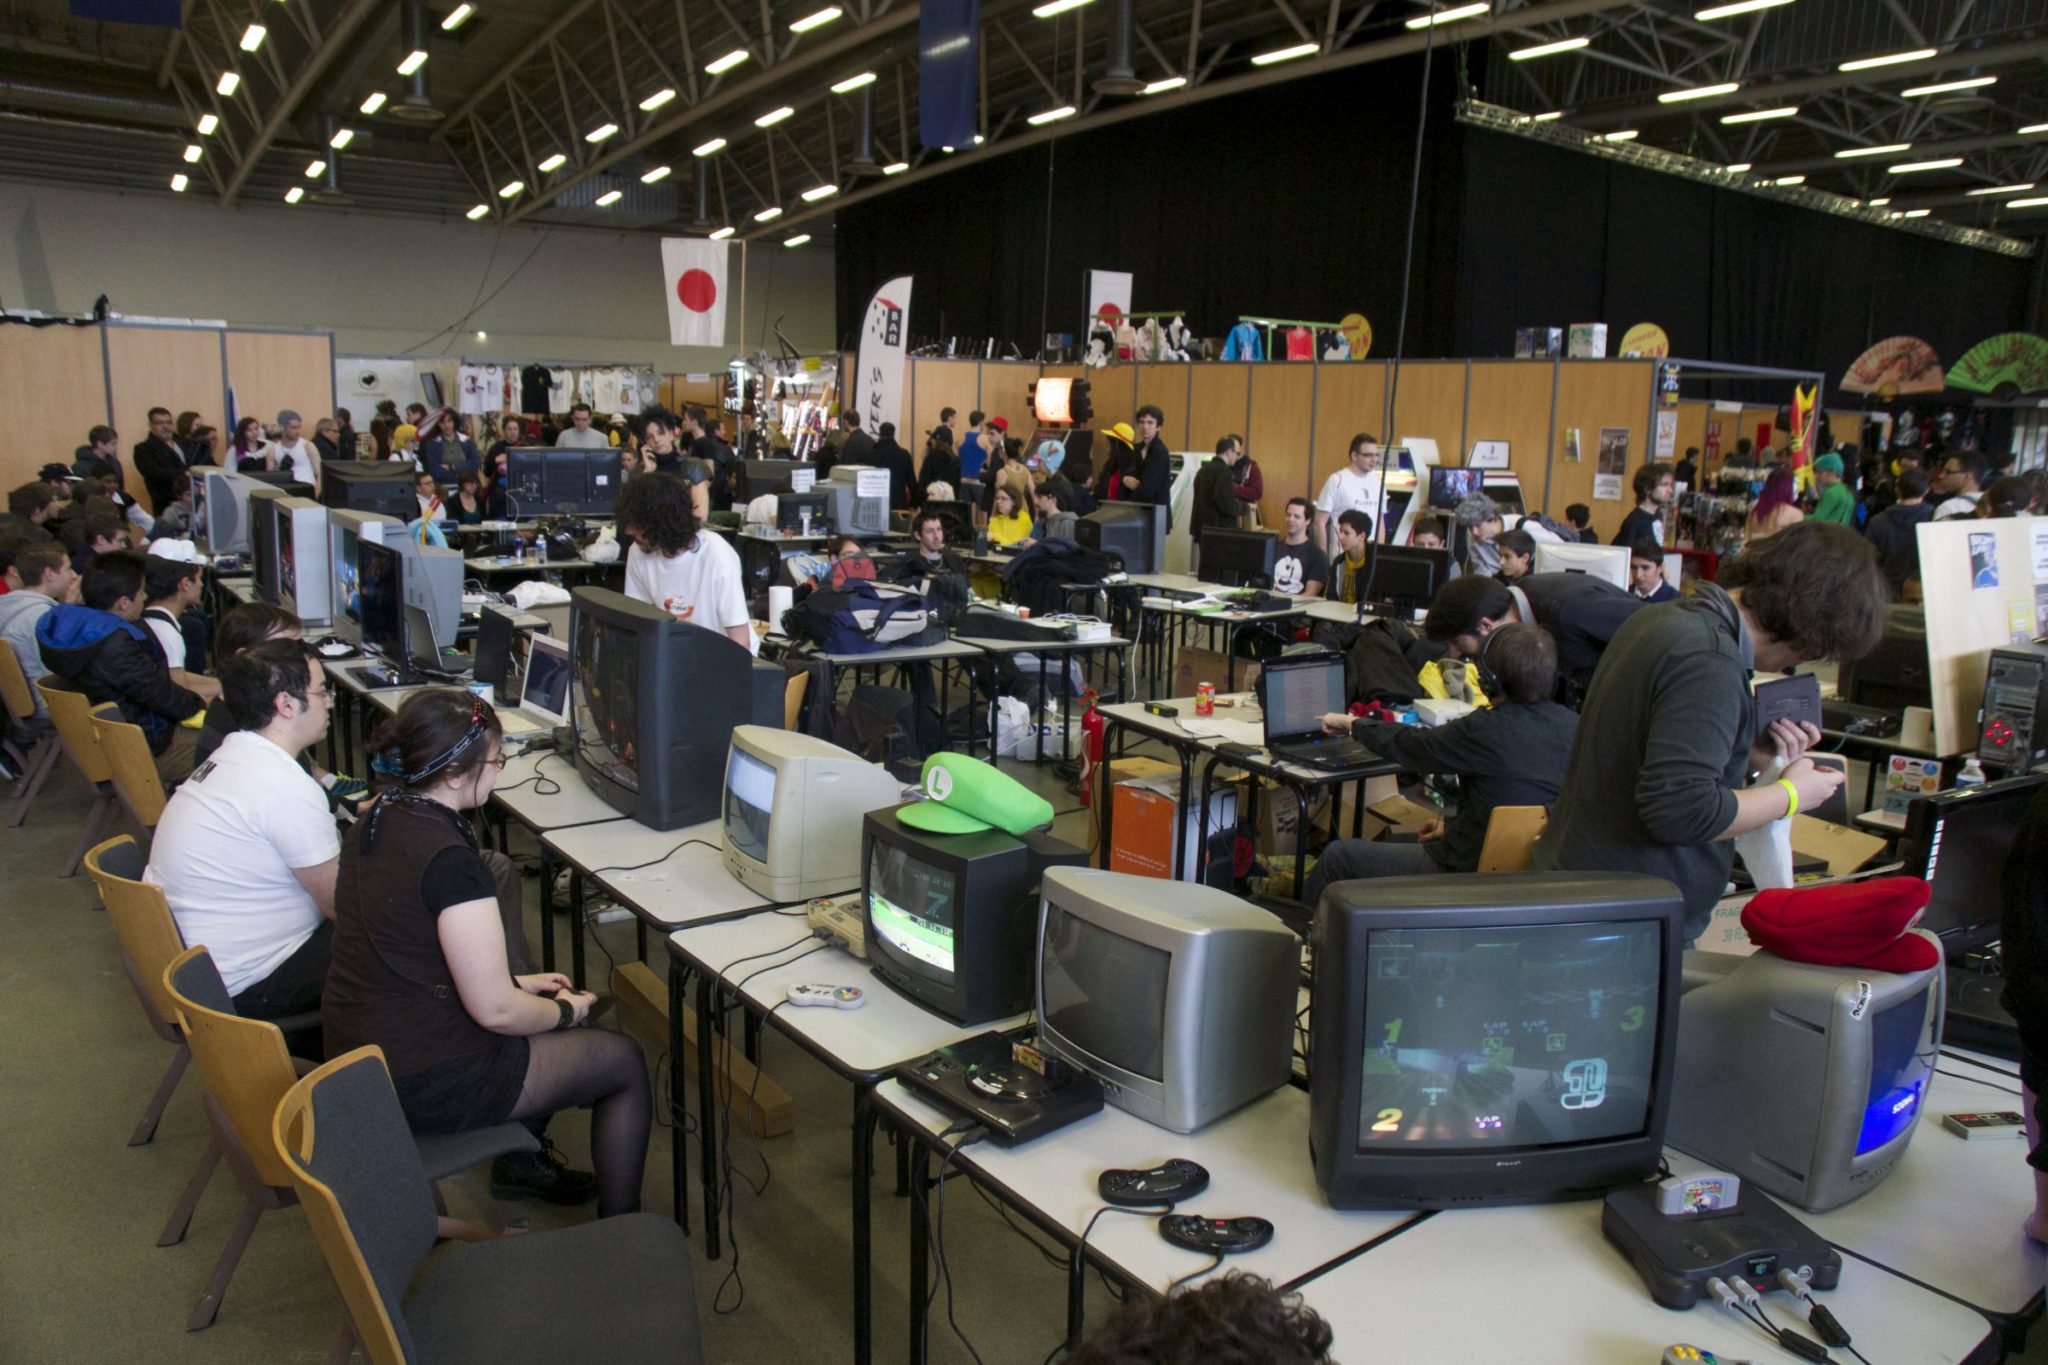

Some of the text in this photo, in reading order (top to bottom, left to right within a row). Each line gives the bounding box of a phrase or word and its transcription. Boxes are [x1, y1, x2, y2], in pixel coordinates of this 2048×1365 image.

[889, 311, 899, 344] BAR
[869, 366, 883, 438] YER'S
[932, 770, 944, 796] L
[1715, 906, 1741, 919] FRAG
[1384, 1017, 1403, 1044] 1
[1371, 1108, 1403, 1132] 2
